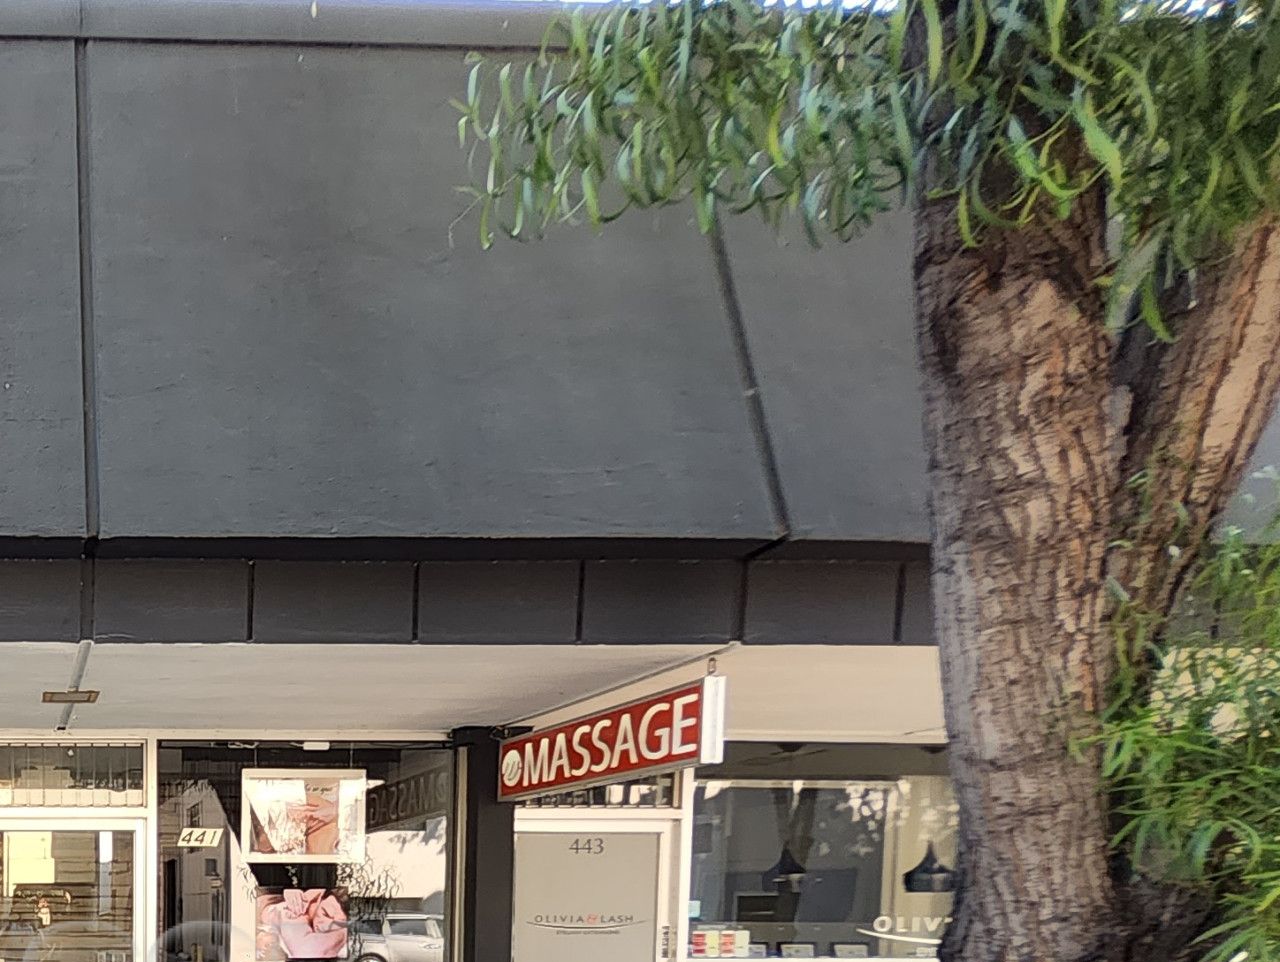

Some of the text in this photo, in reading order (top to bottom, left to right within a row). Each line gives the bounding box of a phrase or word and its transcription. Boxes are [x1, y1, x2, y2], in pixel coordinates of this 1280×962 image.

[523, 693, 699, 787] MASSAGE
[181, 831, 216, 846] 441
[569, 838, 604, 854] 443
[534, 915, 585, 923] OLIVIA
[601, 915, 634, 923] LASH
[873, 916, 953, 932] OLIV
